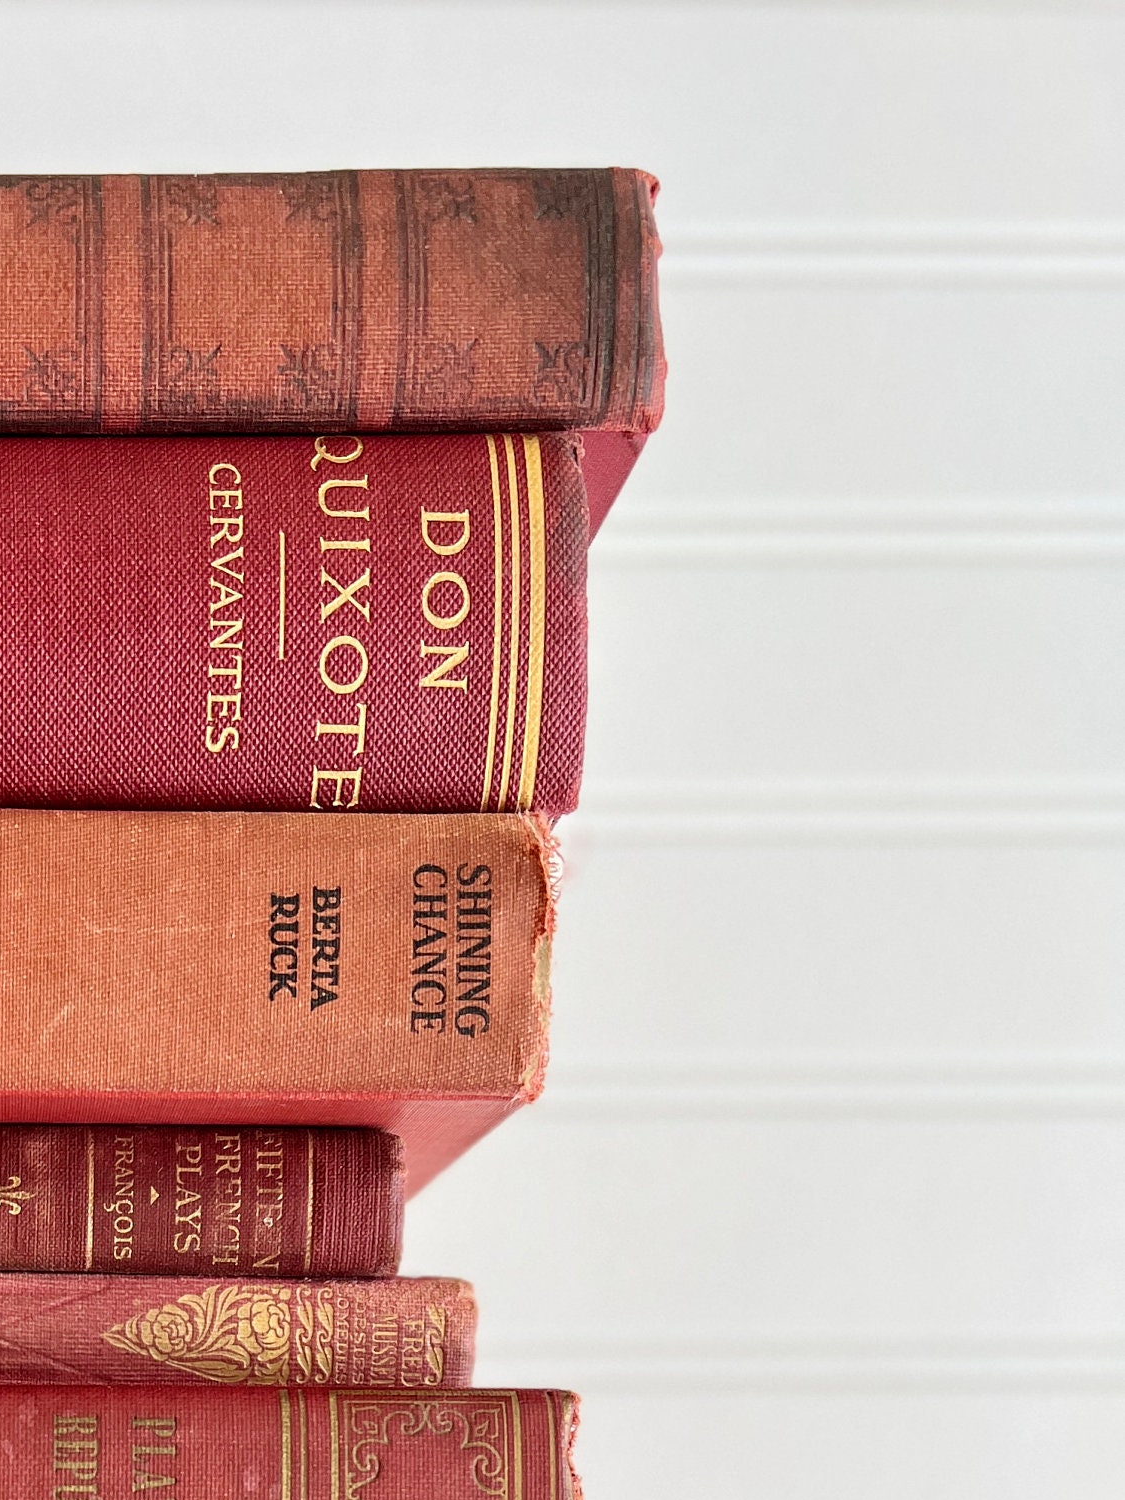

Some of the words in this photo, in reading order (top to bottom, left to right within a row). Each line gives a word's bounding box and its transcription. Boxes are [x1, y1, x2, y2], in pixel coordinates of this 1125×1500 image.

[205, 463, 244, 753] CERVANTES
[310, 434, 371, 810] QUIXOTE
[419, 505, 470, 694] DON
[269, 893, 300, 1002] RUCK
[310, 886, 341, 1011] BERTA
[411, 863, 448, 1034] CHANCE
[455, 862, 492, 1038] SHINING
[104, 1135, 134, 1260] FRANÇOIS
[173, 1143, 202, 1254] PLAYS
[212, 1133, 241, 1266] FRENCH
